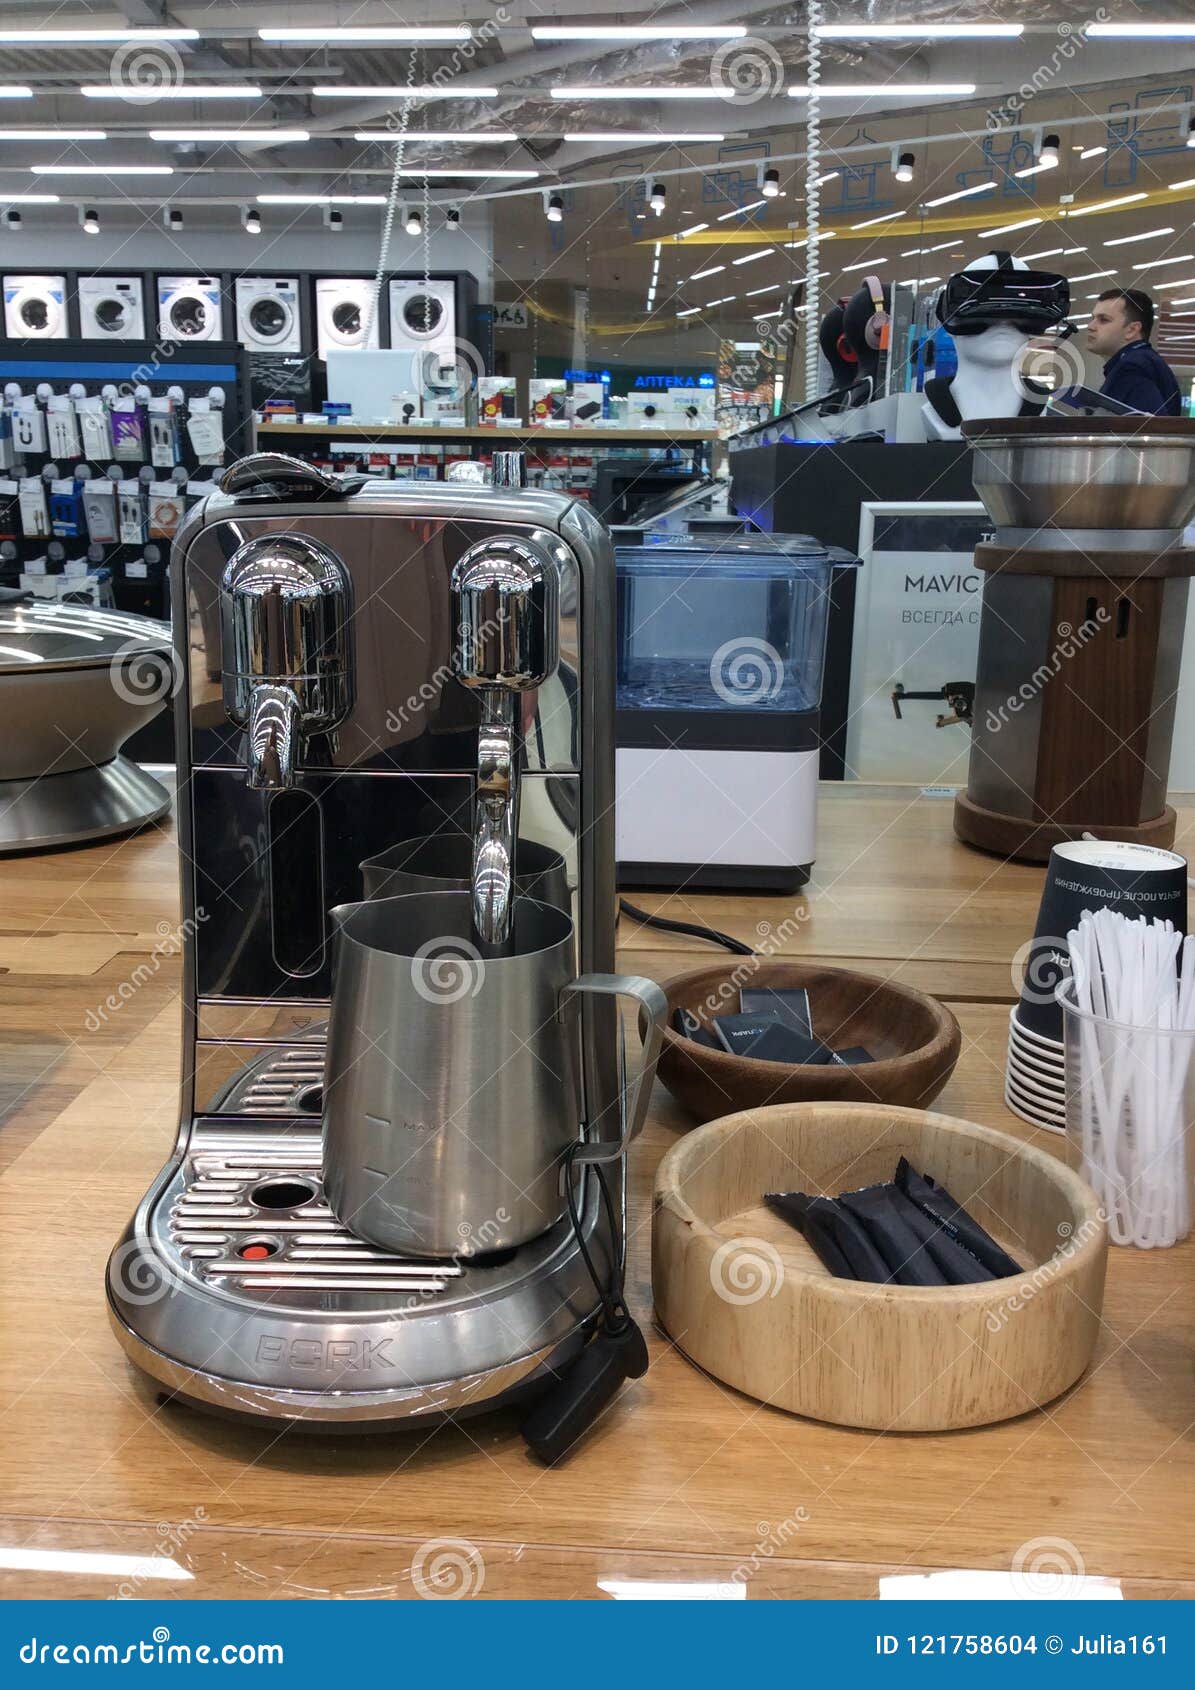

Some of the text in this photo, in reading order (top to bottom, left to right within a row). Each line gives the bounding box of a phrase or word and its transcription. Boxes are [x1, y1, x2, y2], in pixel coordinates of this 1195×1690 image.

[635, 375, 695, 387] АПТЕКА
[904, 575, 980, 593] MAVIC
[902, 610, 964, 626] ВСЕГДА
[1054, 877, 1122, 900] ПРОБУЖДЕНИЯ
[1123, 891, 1158, 902] ПОСЛЕ
[255, 1334, 396, 1372] BORK
